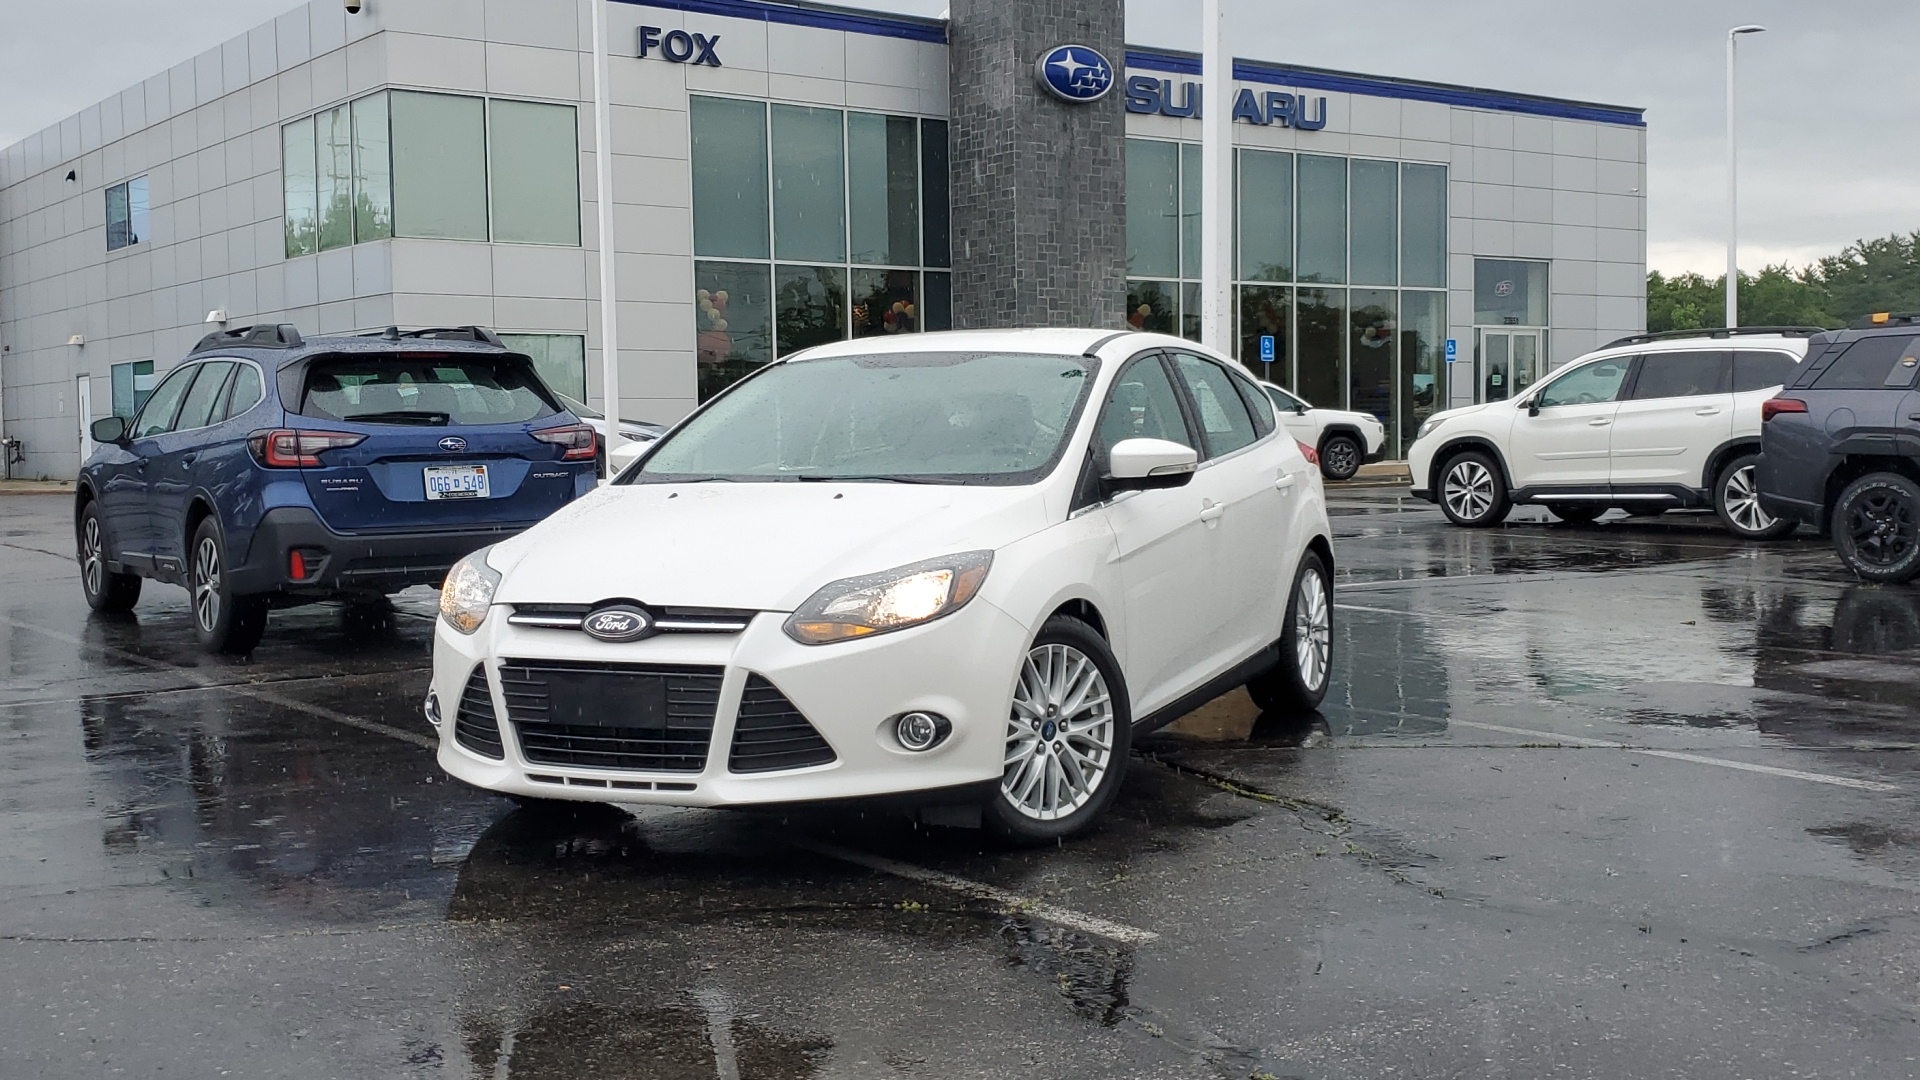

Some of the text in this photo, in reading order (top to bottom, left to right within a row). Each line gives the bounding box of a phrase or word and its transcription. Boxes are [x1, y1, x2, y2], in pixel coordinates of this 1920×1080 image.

[637, 25, 722, 67] FOX
[1126, 75, 1327, 131] SUARU
[430, 476, 451, 492] 066
[463, 475, 484, 490] 548
[595, 614, 631, 631] Ford
